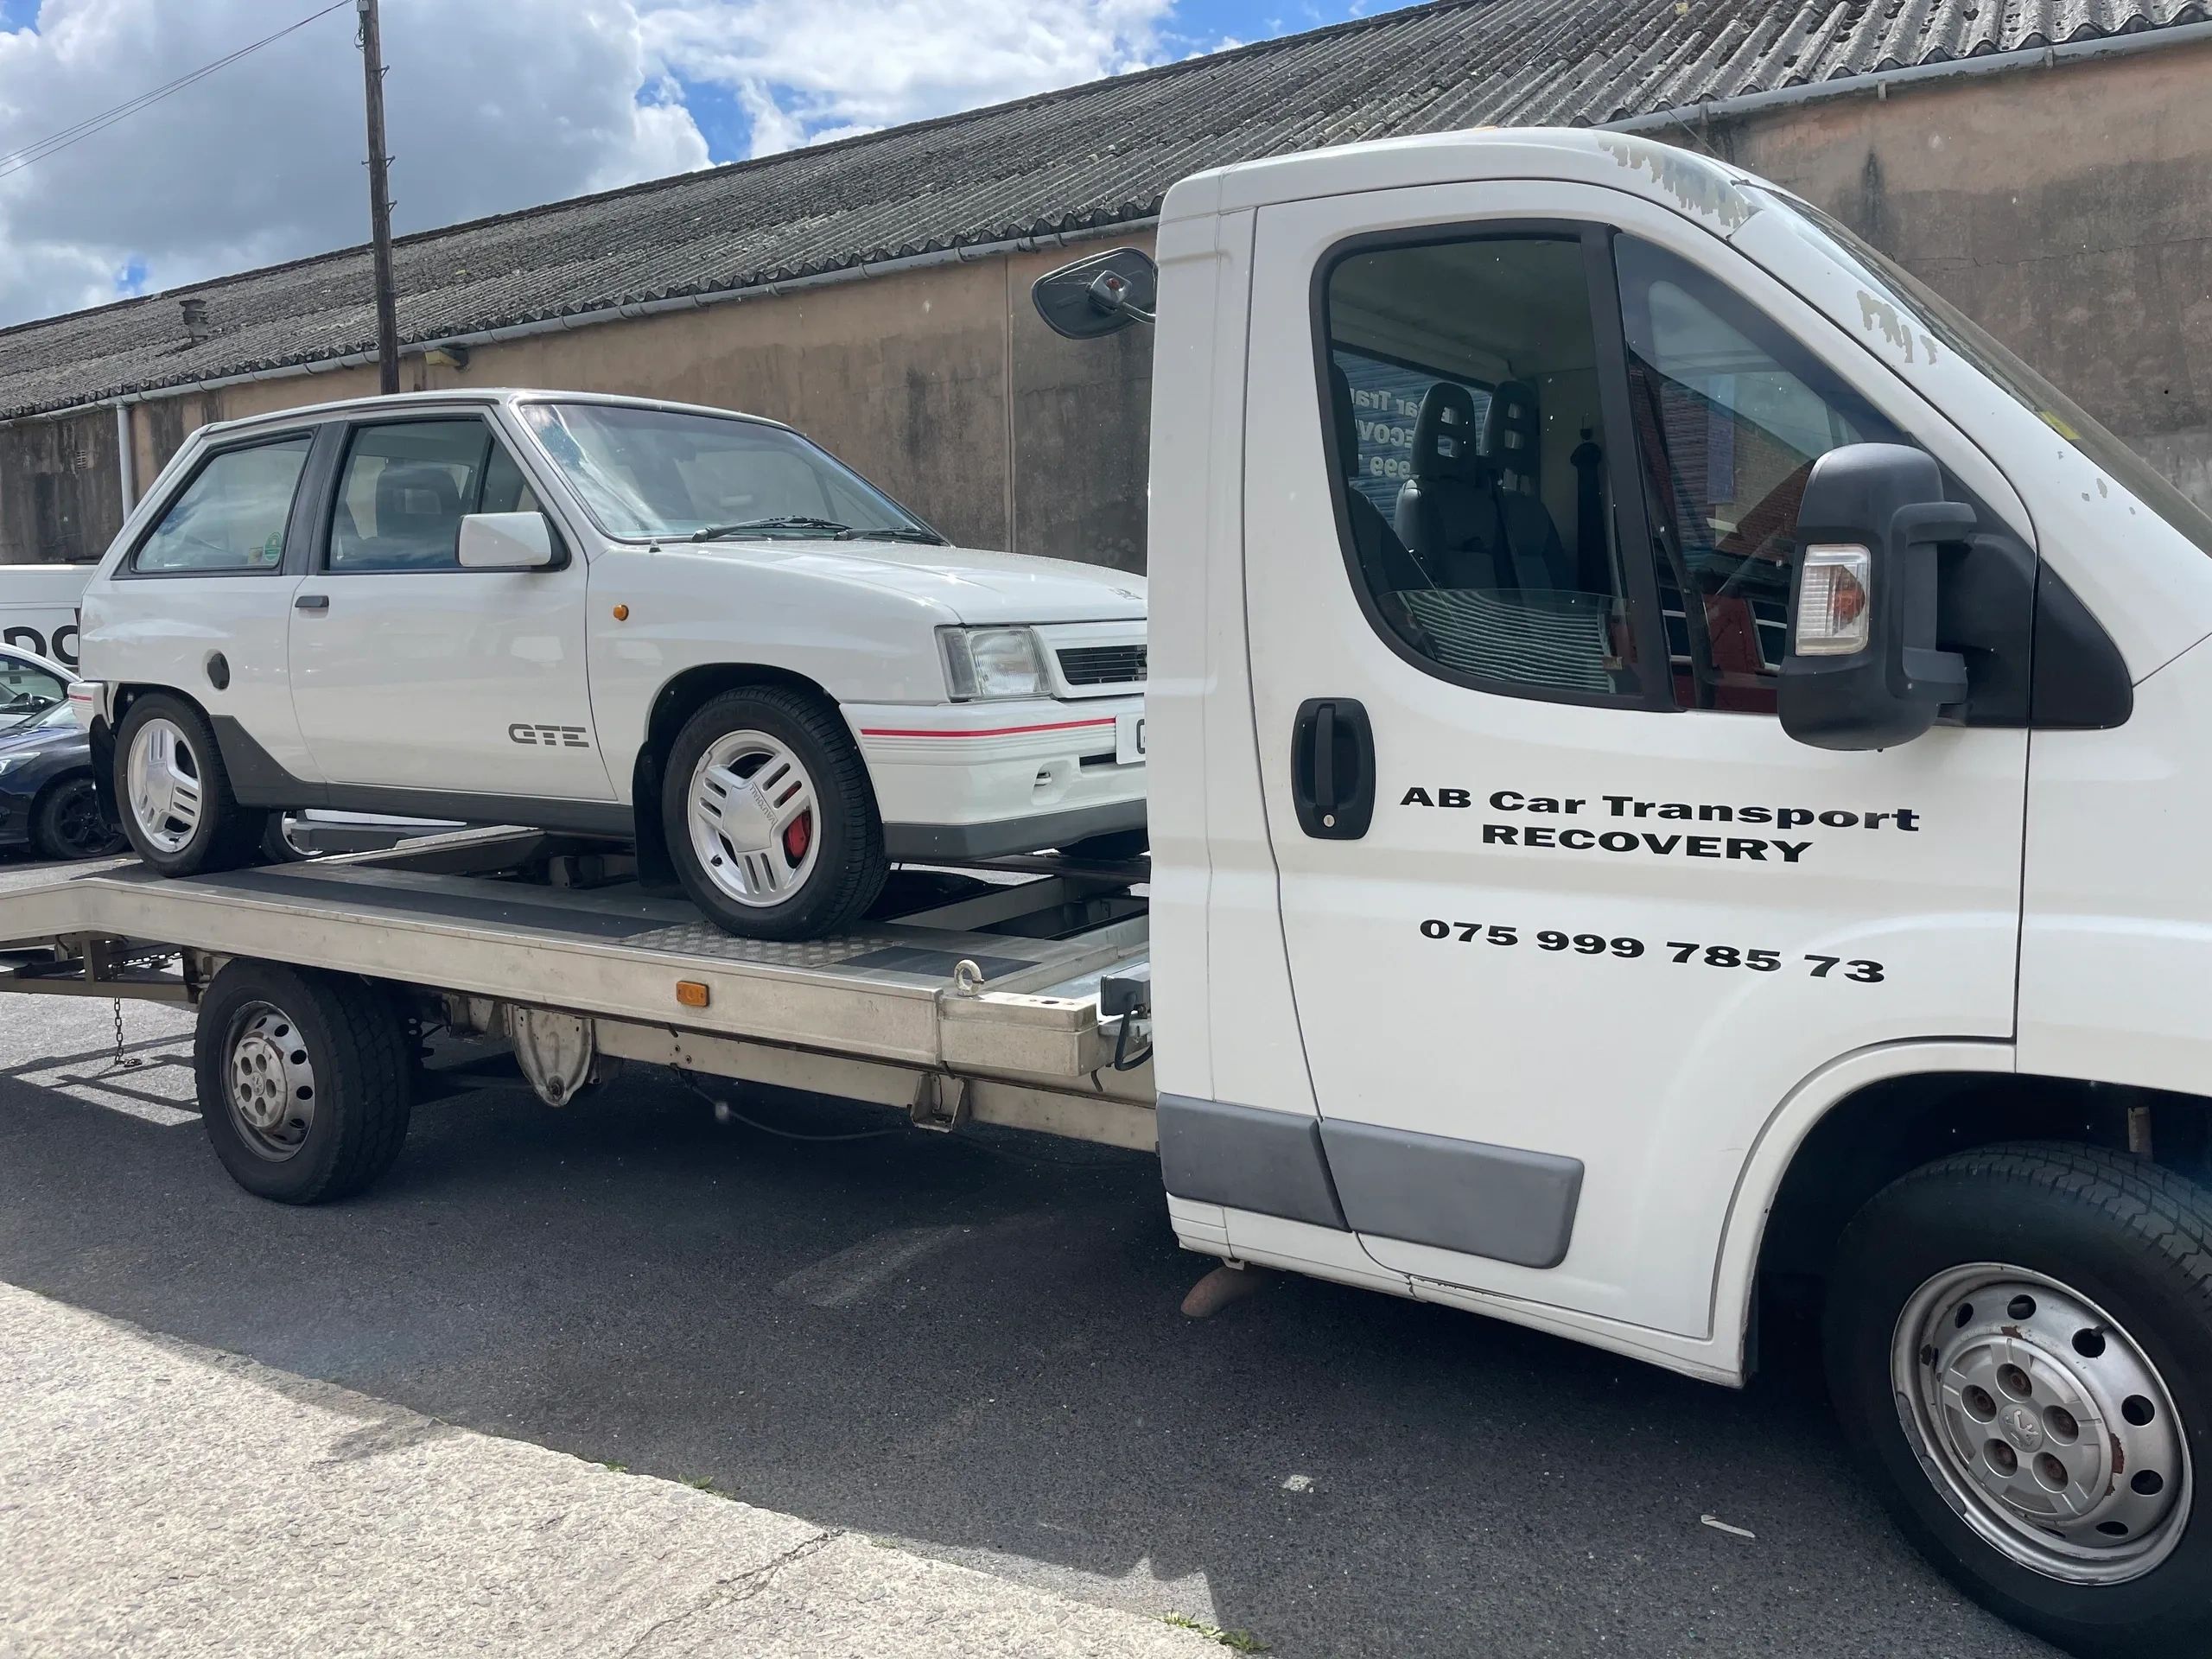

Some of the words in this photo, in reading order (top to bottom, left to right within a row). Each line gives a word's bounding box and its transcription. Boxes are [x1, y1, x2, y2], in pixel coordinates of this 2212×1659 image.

[508, 723, 589, 747] GTE
[1400, 786, 1471, 809] AB
[1489, 791, 1586, 815] Car
[1602, 795, 1920, 832] Transport
[1482, 823, 1814, 863] RECOVERY
[1420, 919, 1518, 946] 075
[1536, 931, 1645, 958] 999
[1666, 941, 1782, 972] 785
[1803, 954, 1885, 983] 73
